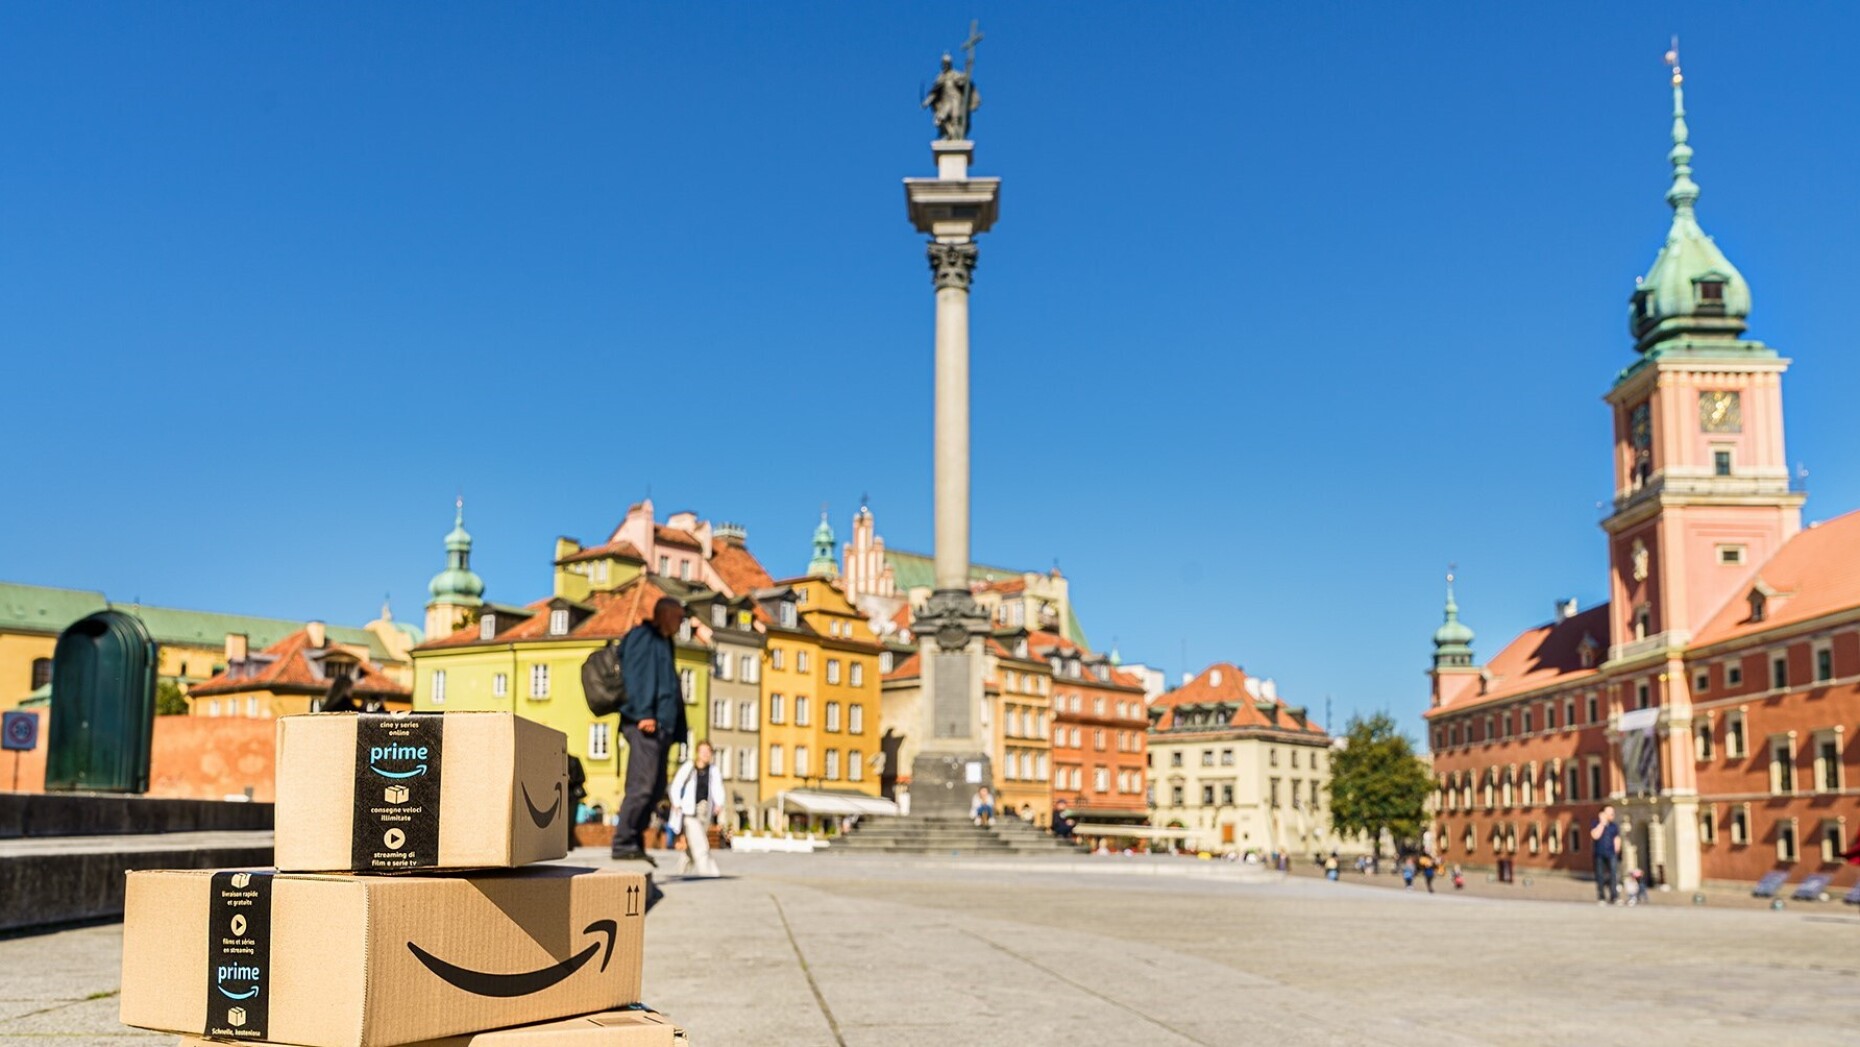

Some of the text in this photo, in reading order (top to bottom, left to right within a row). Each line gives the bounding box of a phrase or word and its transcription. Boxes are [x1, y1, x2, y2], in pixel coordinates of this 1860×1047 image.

[370, 742, 428, 764] prime
[230, 947, 254, 955] streaming
[218, 961, 260, 984] prime
